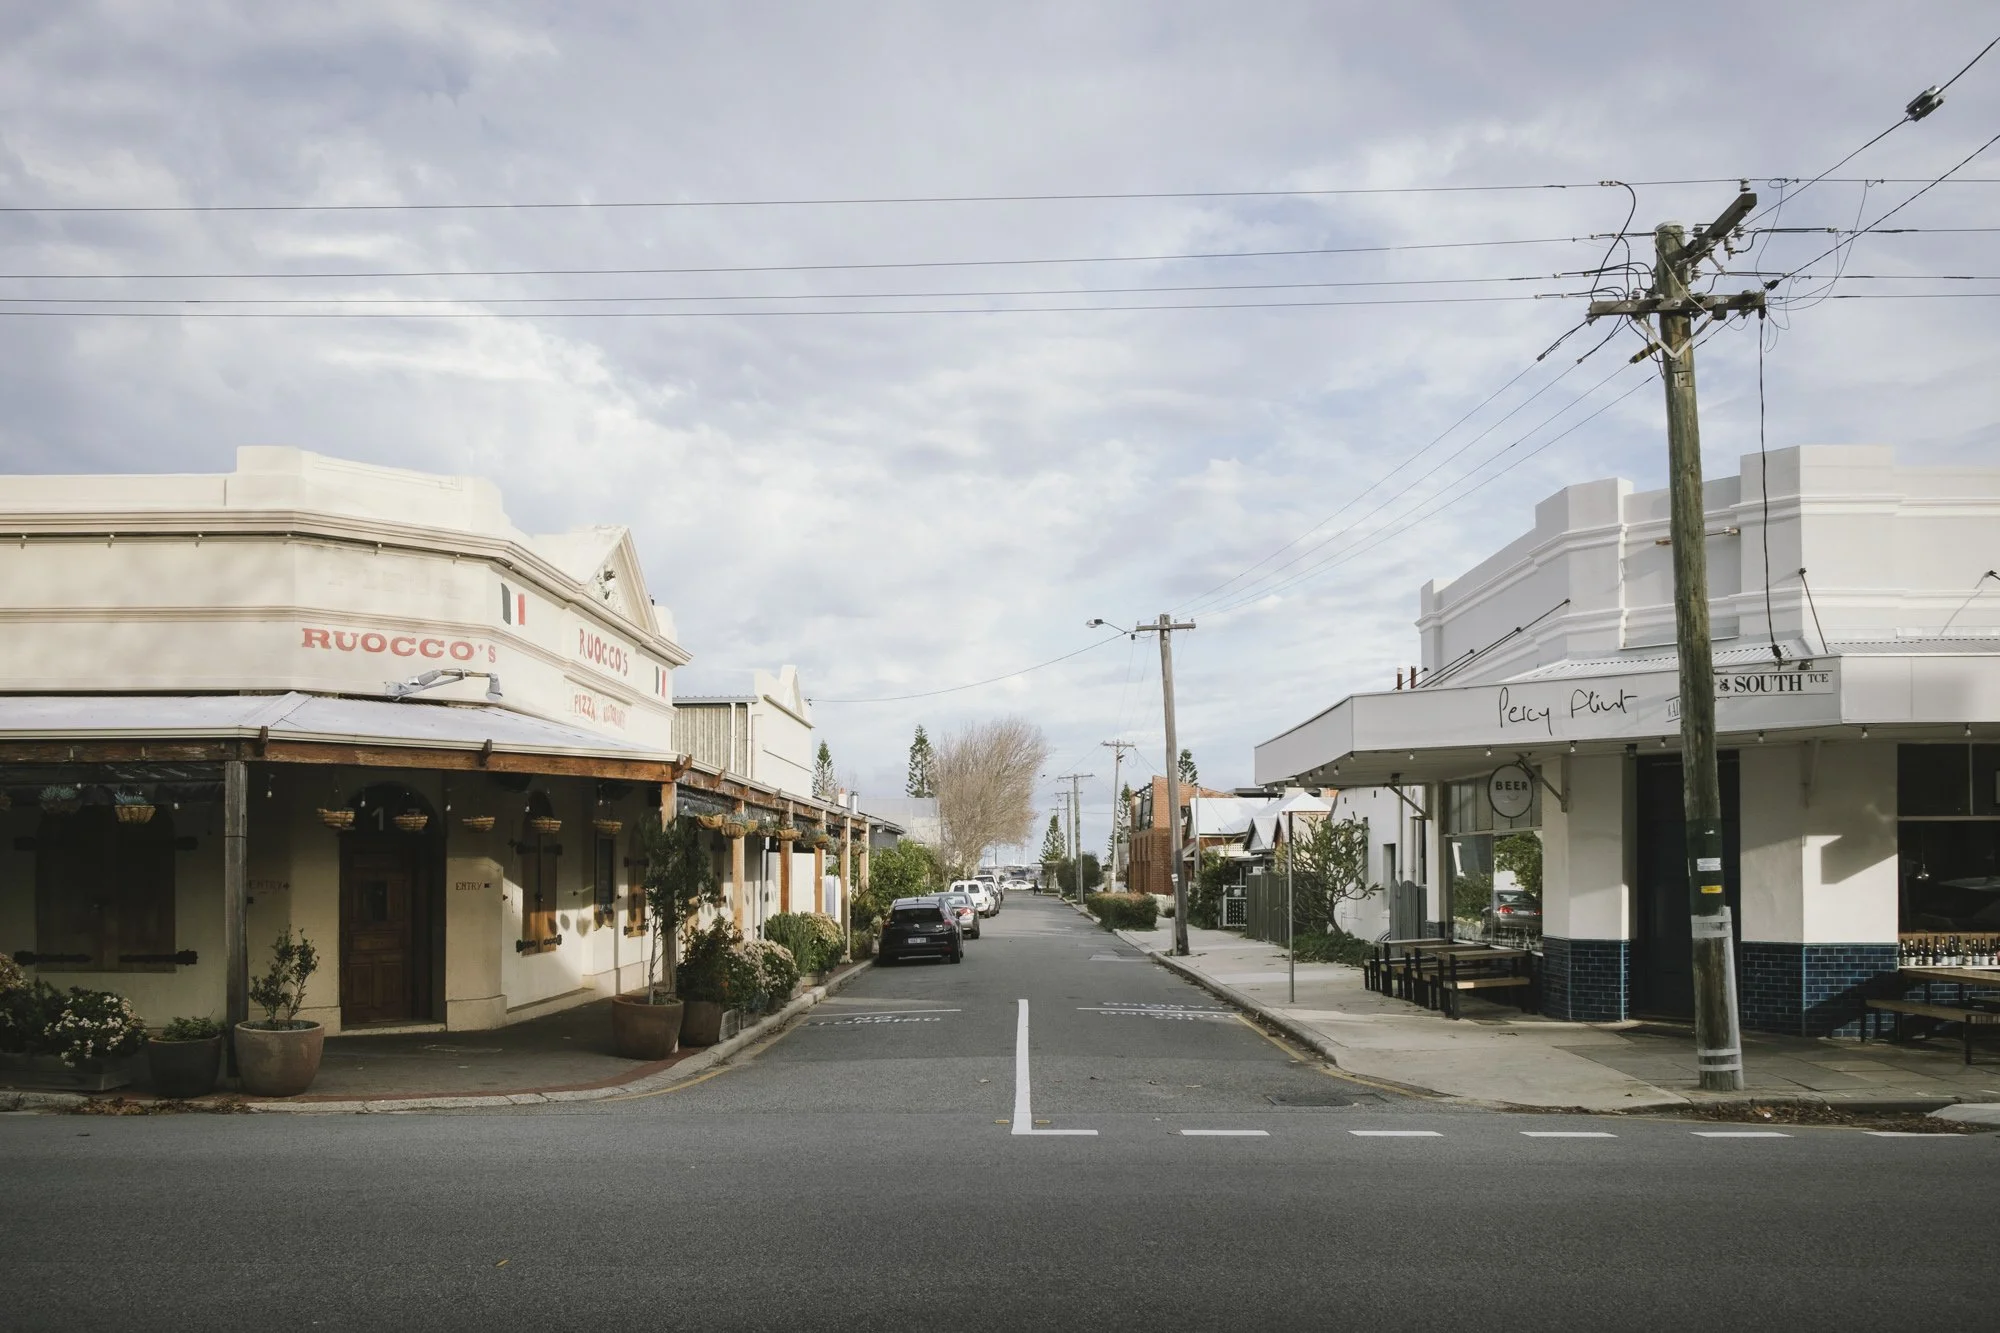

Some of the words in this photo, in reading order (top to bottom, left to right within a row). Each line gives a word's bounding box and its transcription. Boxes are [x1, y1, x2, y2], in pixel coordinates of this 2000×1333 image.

[302, 627, 496, 663] RUOCCO'S
[579, 628, 628, 677] RUOCCO'S
[1734, 674, 1803, 693] SOUTH
[1808, 673, 1829, 683] TCE
[574, 694, 596, 722] PIZZA
[1499, 687, 1552, 736] Percy
[1570, 689, 1638, 718] Flint
[1495, 781, 1527, 791] BEER
[455, 880, 483, 891] ENTRY
